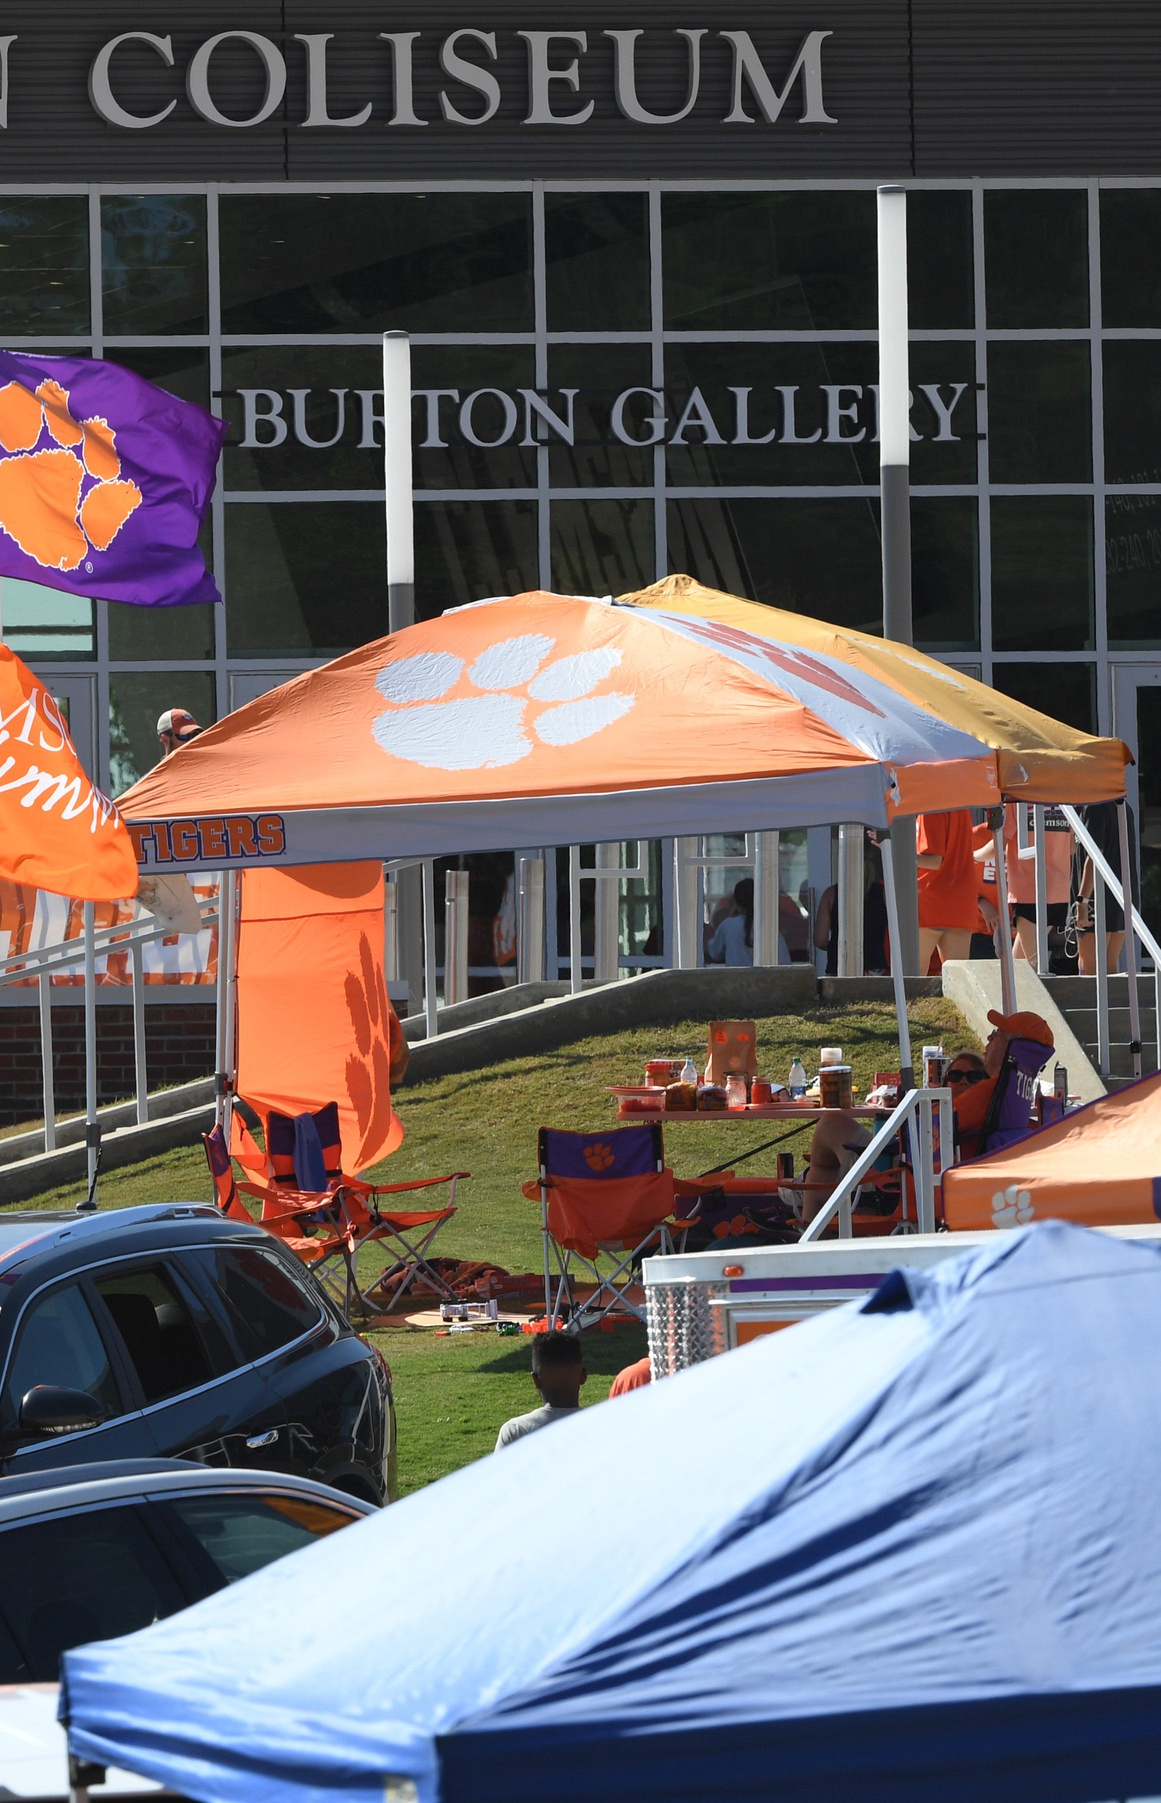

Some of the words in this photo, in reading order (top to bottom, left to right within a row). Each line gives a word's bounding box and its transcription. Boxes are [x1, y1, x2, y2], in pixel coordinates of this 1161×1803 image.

[87, 28, 838, 130] COLISEUM
[126, 813, 287, 865] TIGERS
[1029, 818, 1070, 828] cmson
